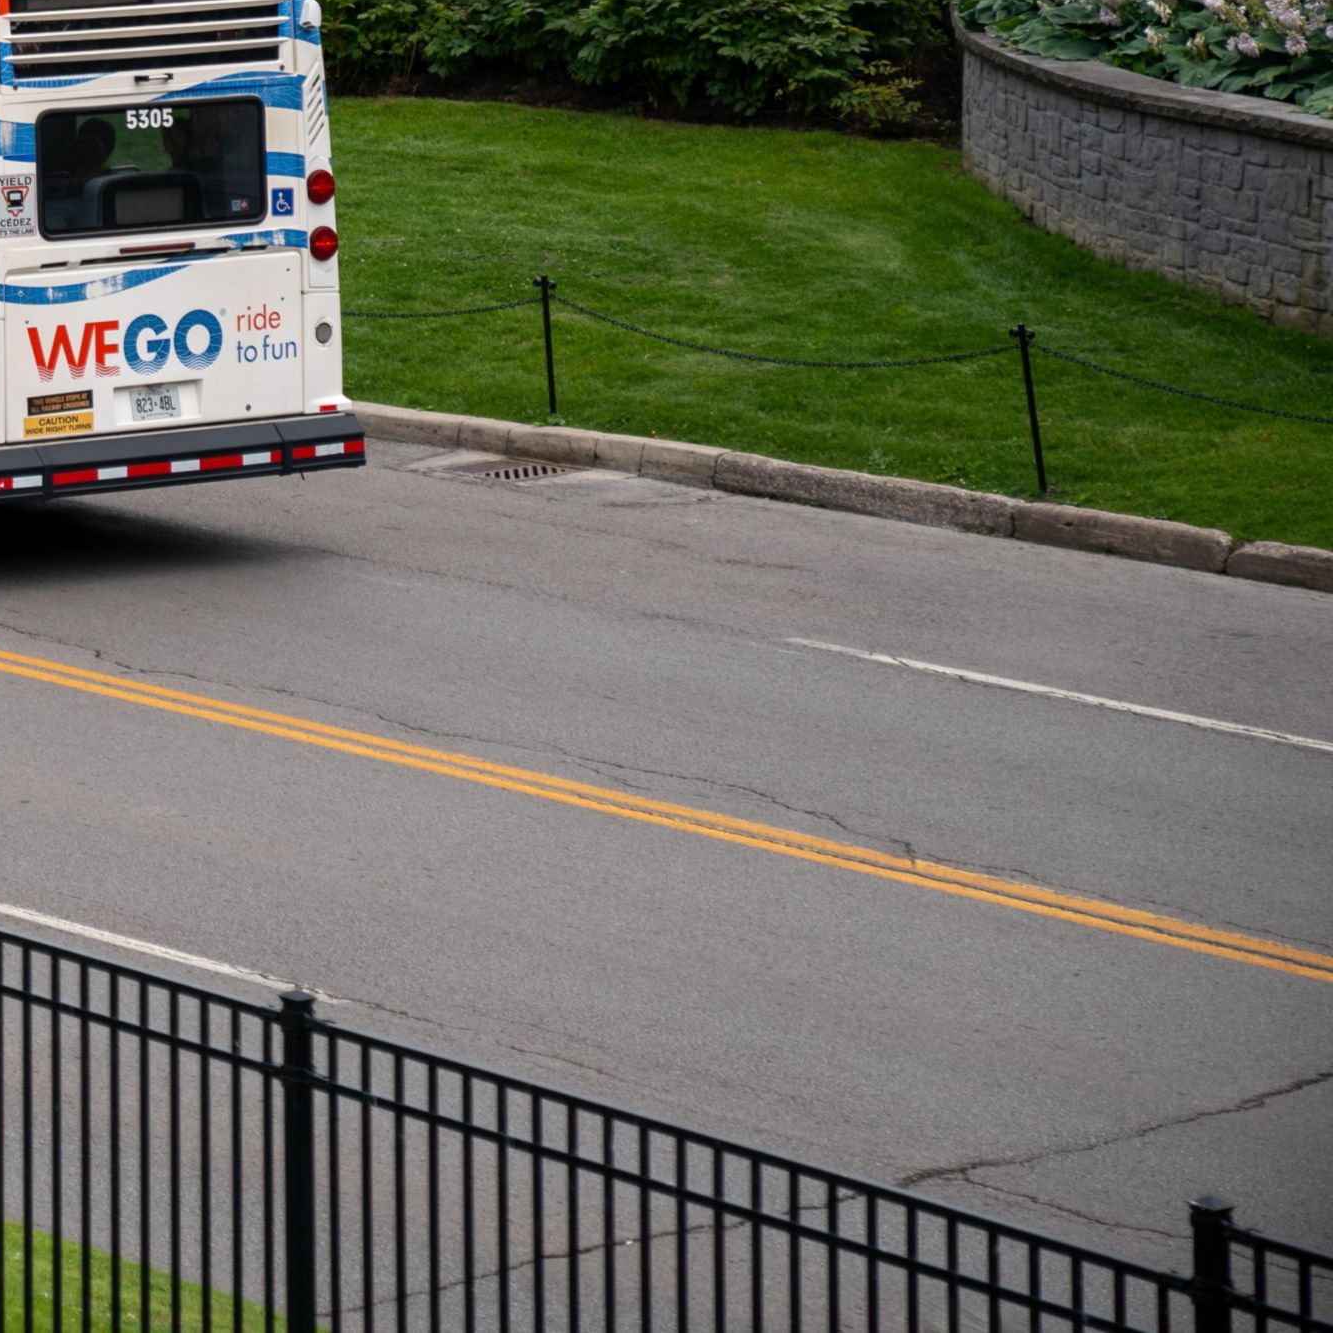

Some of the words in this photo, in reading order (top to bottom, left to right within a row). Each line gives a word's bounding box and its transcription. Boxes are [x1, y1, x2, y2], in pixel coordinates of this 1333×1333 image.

[126, 107, 174, 129] 5305
[0, 217, 32, 228] CÉDEZ
[236, 303, 281, 332] ride
[26, 308, 223, 384] WEGO
[236, 340, 258, 363] to
[262, 334, 298, 361] fun
[38, 416, 79, 426] CAUTION
[45, 425, 67, 433] RIGHT
[68, 423, 92, 431] TURNS
